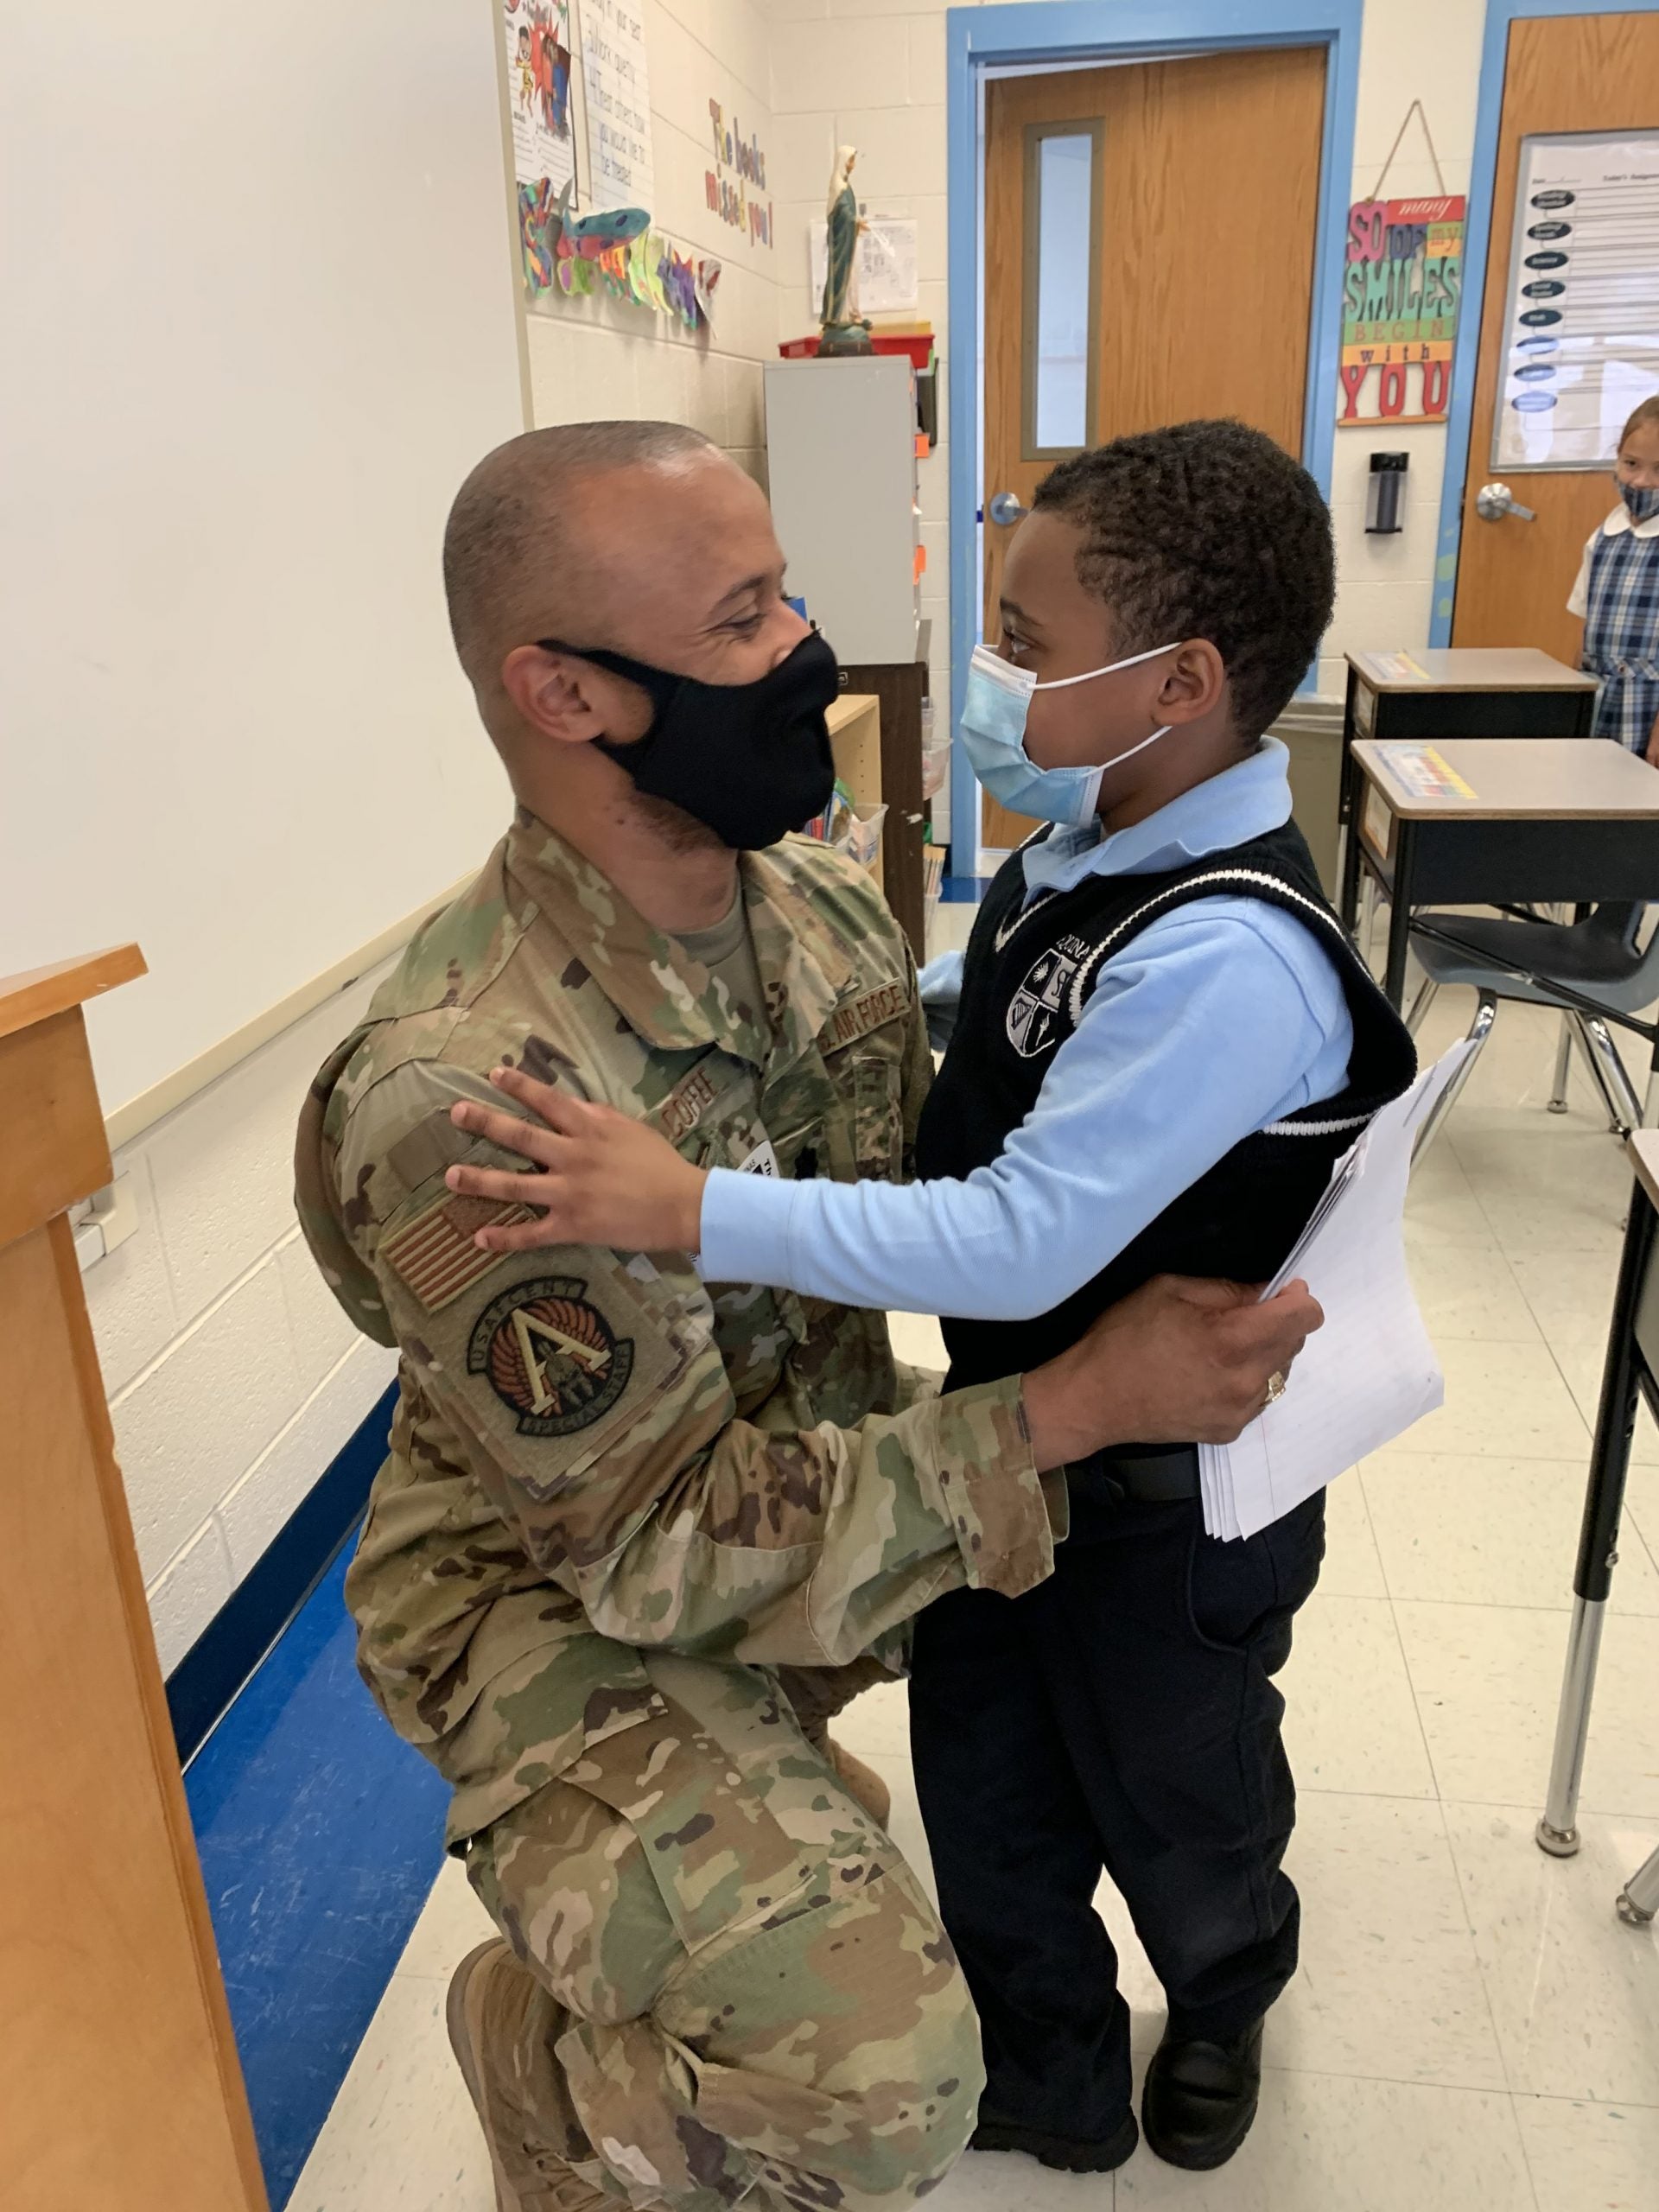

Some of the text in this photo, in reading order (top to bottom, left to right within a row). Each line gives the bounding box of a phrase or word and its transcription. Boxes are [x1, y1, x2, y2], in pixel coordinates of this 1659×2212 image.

[1348, 199, 1452, 262] SO many
[1430, 226, 1459, 251] my
[1344, 257, 1460, 321] SMILES
[1354, 321, 1445, 341] BEGIN
[1360, 344, 1430, 363] with
[1340, 360, 1452, 418] YOU
[832, 1007, 863, 1043] AIR
[856, 985, 906, 1031] FORCE
